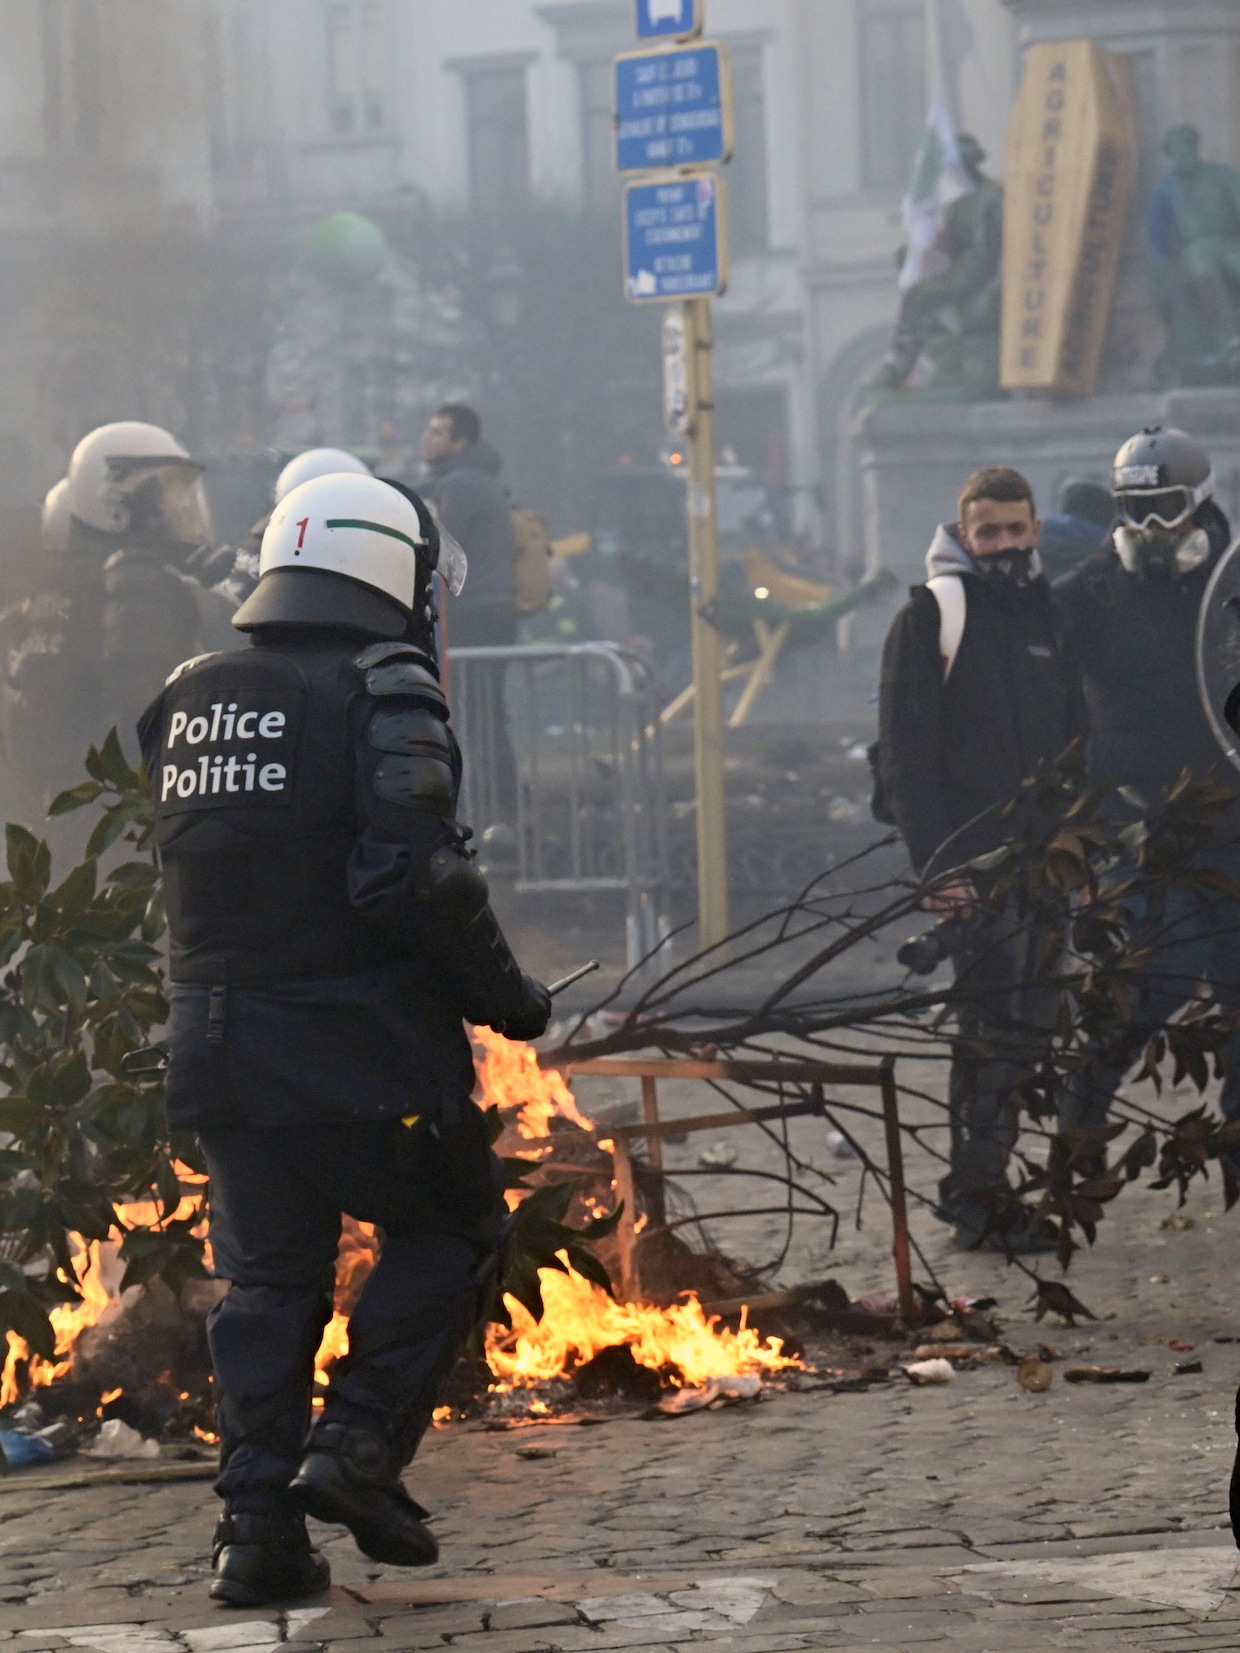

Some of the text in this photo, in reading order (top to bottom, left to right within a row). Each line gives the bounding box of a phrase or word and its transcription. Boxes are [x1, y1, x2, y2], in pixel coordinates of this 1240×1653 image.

[1019, 61, 1068, 369] AGRICULTURE
[296, 517, 309, 548] 1
[168, 703, 286, 749] Police
[161, 753, 287, 802] Politie
